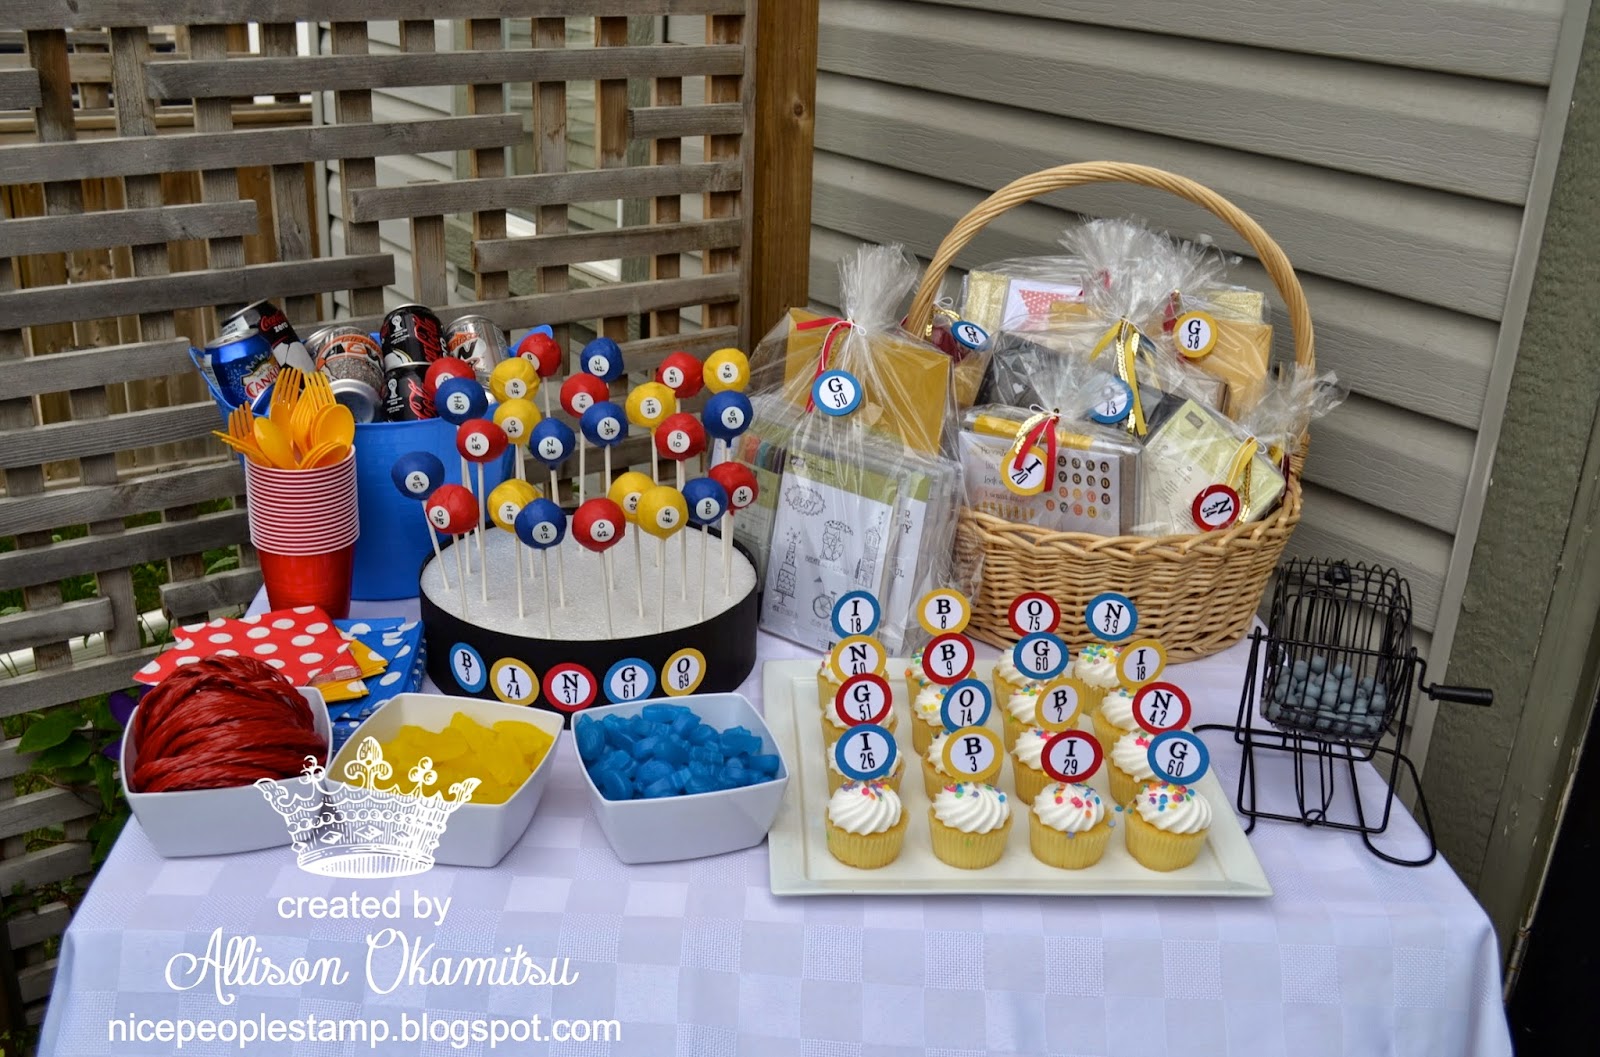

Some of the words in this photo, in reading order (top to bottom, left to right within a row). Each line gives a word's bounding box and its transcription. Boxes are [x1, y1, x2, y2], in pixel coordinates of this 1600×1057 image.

[1188, 319, 1201, 335] G
[1187, 334, 1200, 349] 58
[827, 377, 843, 393] G
[833, 393, 848, 408] 50
[1025, 458, 1042, 474] I
[1011, 468, 1029, 485] 20
[1217, 497, 1232, 515] N
[851, 600, 860, 617] I
[936, 599, 951, 615] B
[1027, 600, 1043, 616] O
[1104, 602, 1124, 620] N
[850, 618, 862, 633] 18
[941, 615, 947, 630] 8
[1028, 616, 1041, 631] 75
[1103, 618, 1119, 634] 39
[848, 644, 868, 662] N
[940, 643, 956, 661] B
[1033, 640, 1050, 657] G
[461, 651, 472, 668] B
[1035, 657, 1049, 672] 60
[1136, 649, 1147, 666] I
[677, 658, 690, 674] O
[946, 661, 953, 676] 9
[1136, 666, 1146, 681] 18
[464, 668, 471, 682] 3
[509, 667, 518, 683] I
[561, 673, 579, 689] N
[621, 667, 637, 682] G
[678, 673, 690, 689] 69
[506, 684, 522, 699] 24
[563, 688, 579, 704] 37
[623, 684, 636, 699] 61
[853, 684, 871, 704] G
[959, 689, 975, 708] O
[1053, 690, 1068, 709] B
[1151, 690, 1173, 711] N
[858, 704, 872, 721] 51
[960, 709, 973, 726] 74
[1056, 708, 1063, 722] 2
[1149, 710, 1168, 727] 42
[860, 733, 871, 751] I
[963, 737, 982, 756] B
[1065, 740, 1077, 758] I
[1169, 741, 1188, 762] G
[860, 752, 876, 770] 26
[969, 756, 977, 773] 3
[1062, 759, 1078, 776] 29
[1167, 759, 1184, 777] 60
